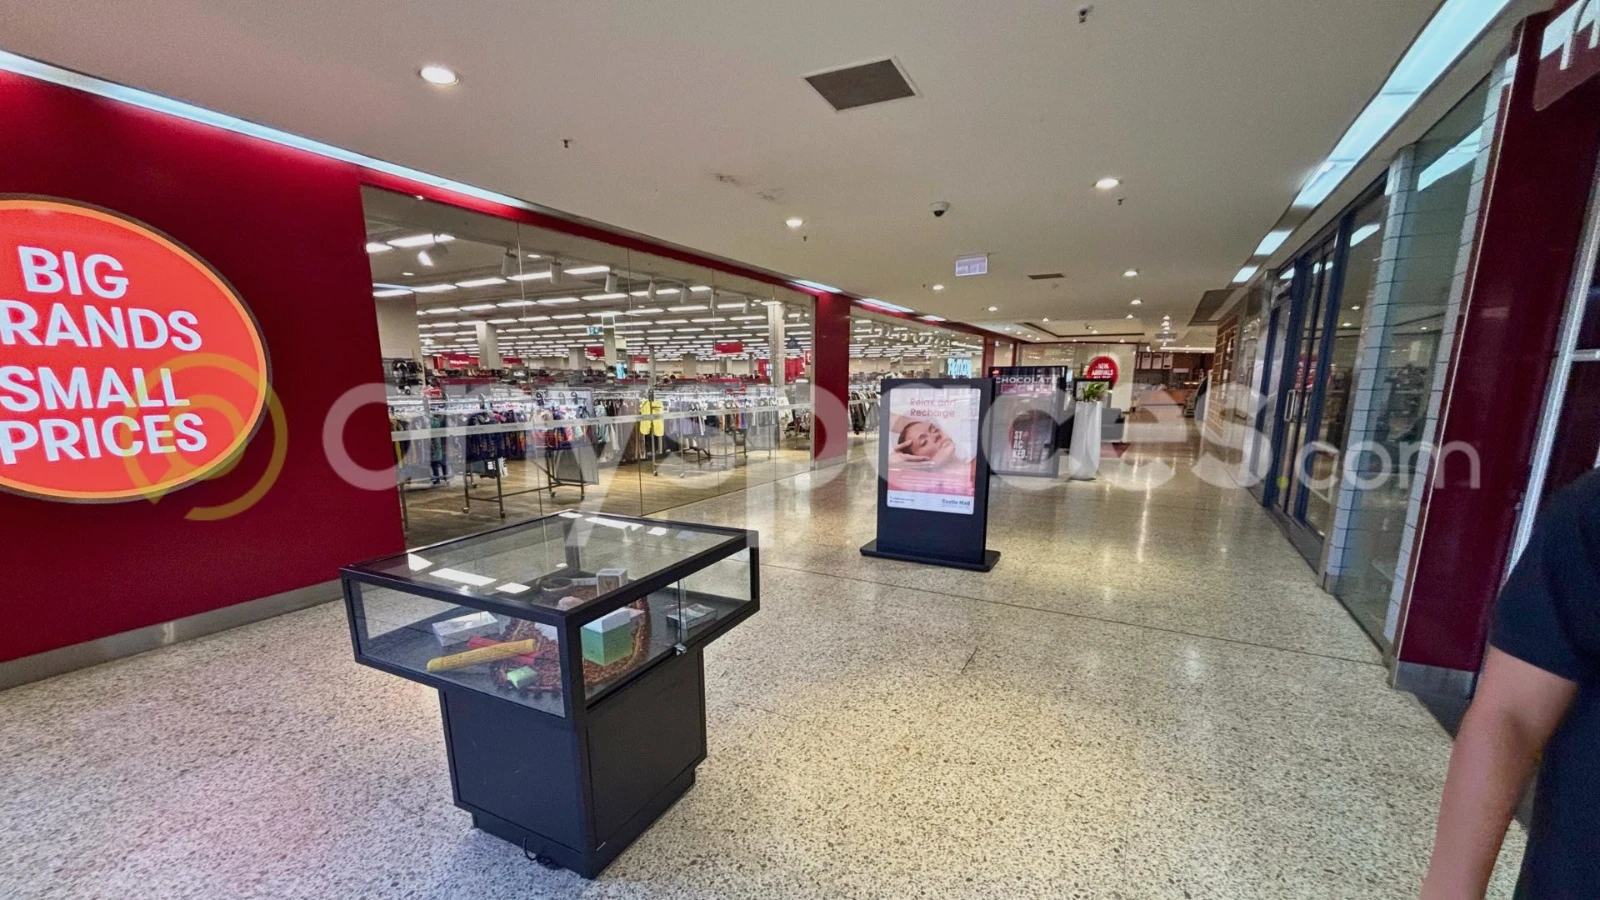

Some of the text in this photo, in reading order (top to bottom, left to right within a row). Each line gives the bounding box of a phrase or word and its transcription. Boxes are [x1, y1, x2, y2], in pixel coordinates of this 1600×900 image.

[18, 246, 129, 299] BIG
[0, 300, 202, 351] RANDS
[0, 366, 190, 412] SMALL
[910, 398, 936, 407] Relax
[910, 409, 955, 419] Recharge
[0, 413, 208, 465] PRICES
